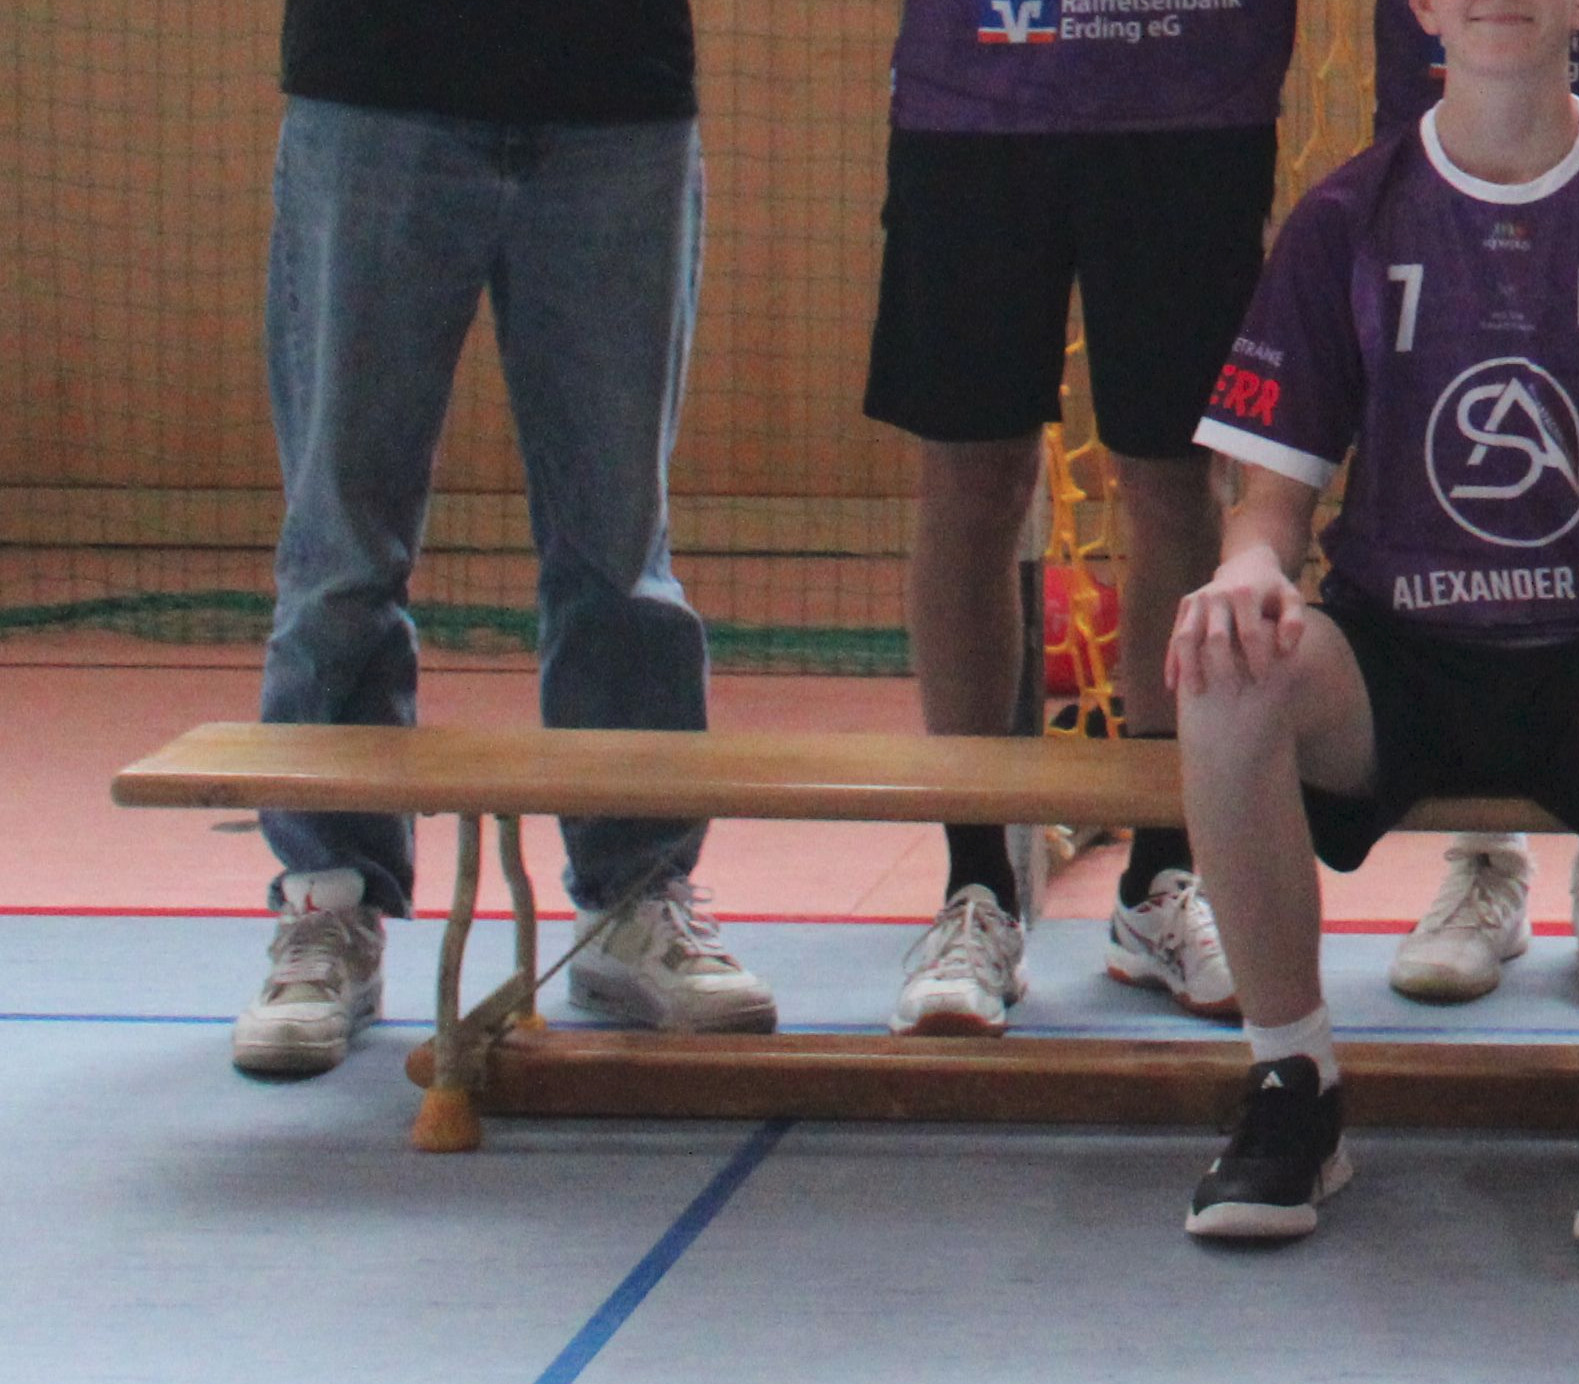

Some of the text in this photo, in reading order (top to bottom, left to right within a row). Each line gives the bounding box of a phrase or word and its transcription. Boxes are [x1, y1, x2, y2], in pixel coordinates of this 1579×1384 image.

[1060, 17, 1181, 42] Erding eG
[1387, 264, 1424, 352] 7
[1393, 568, 1576, 610] ALEXANDER
